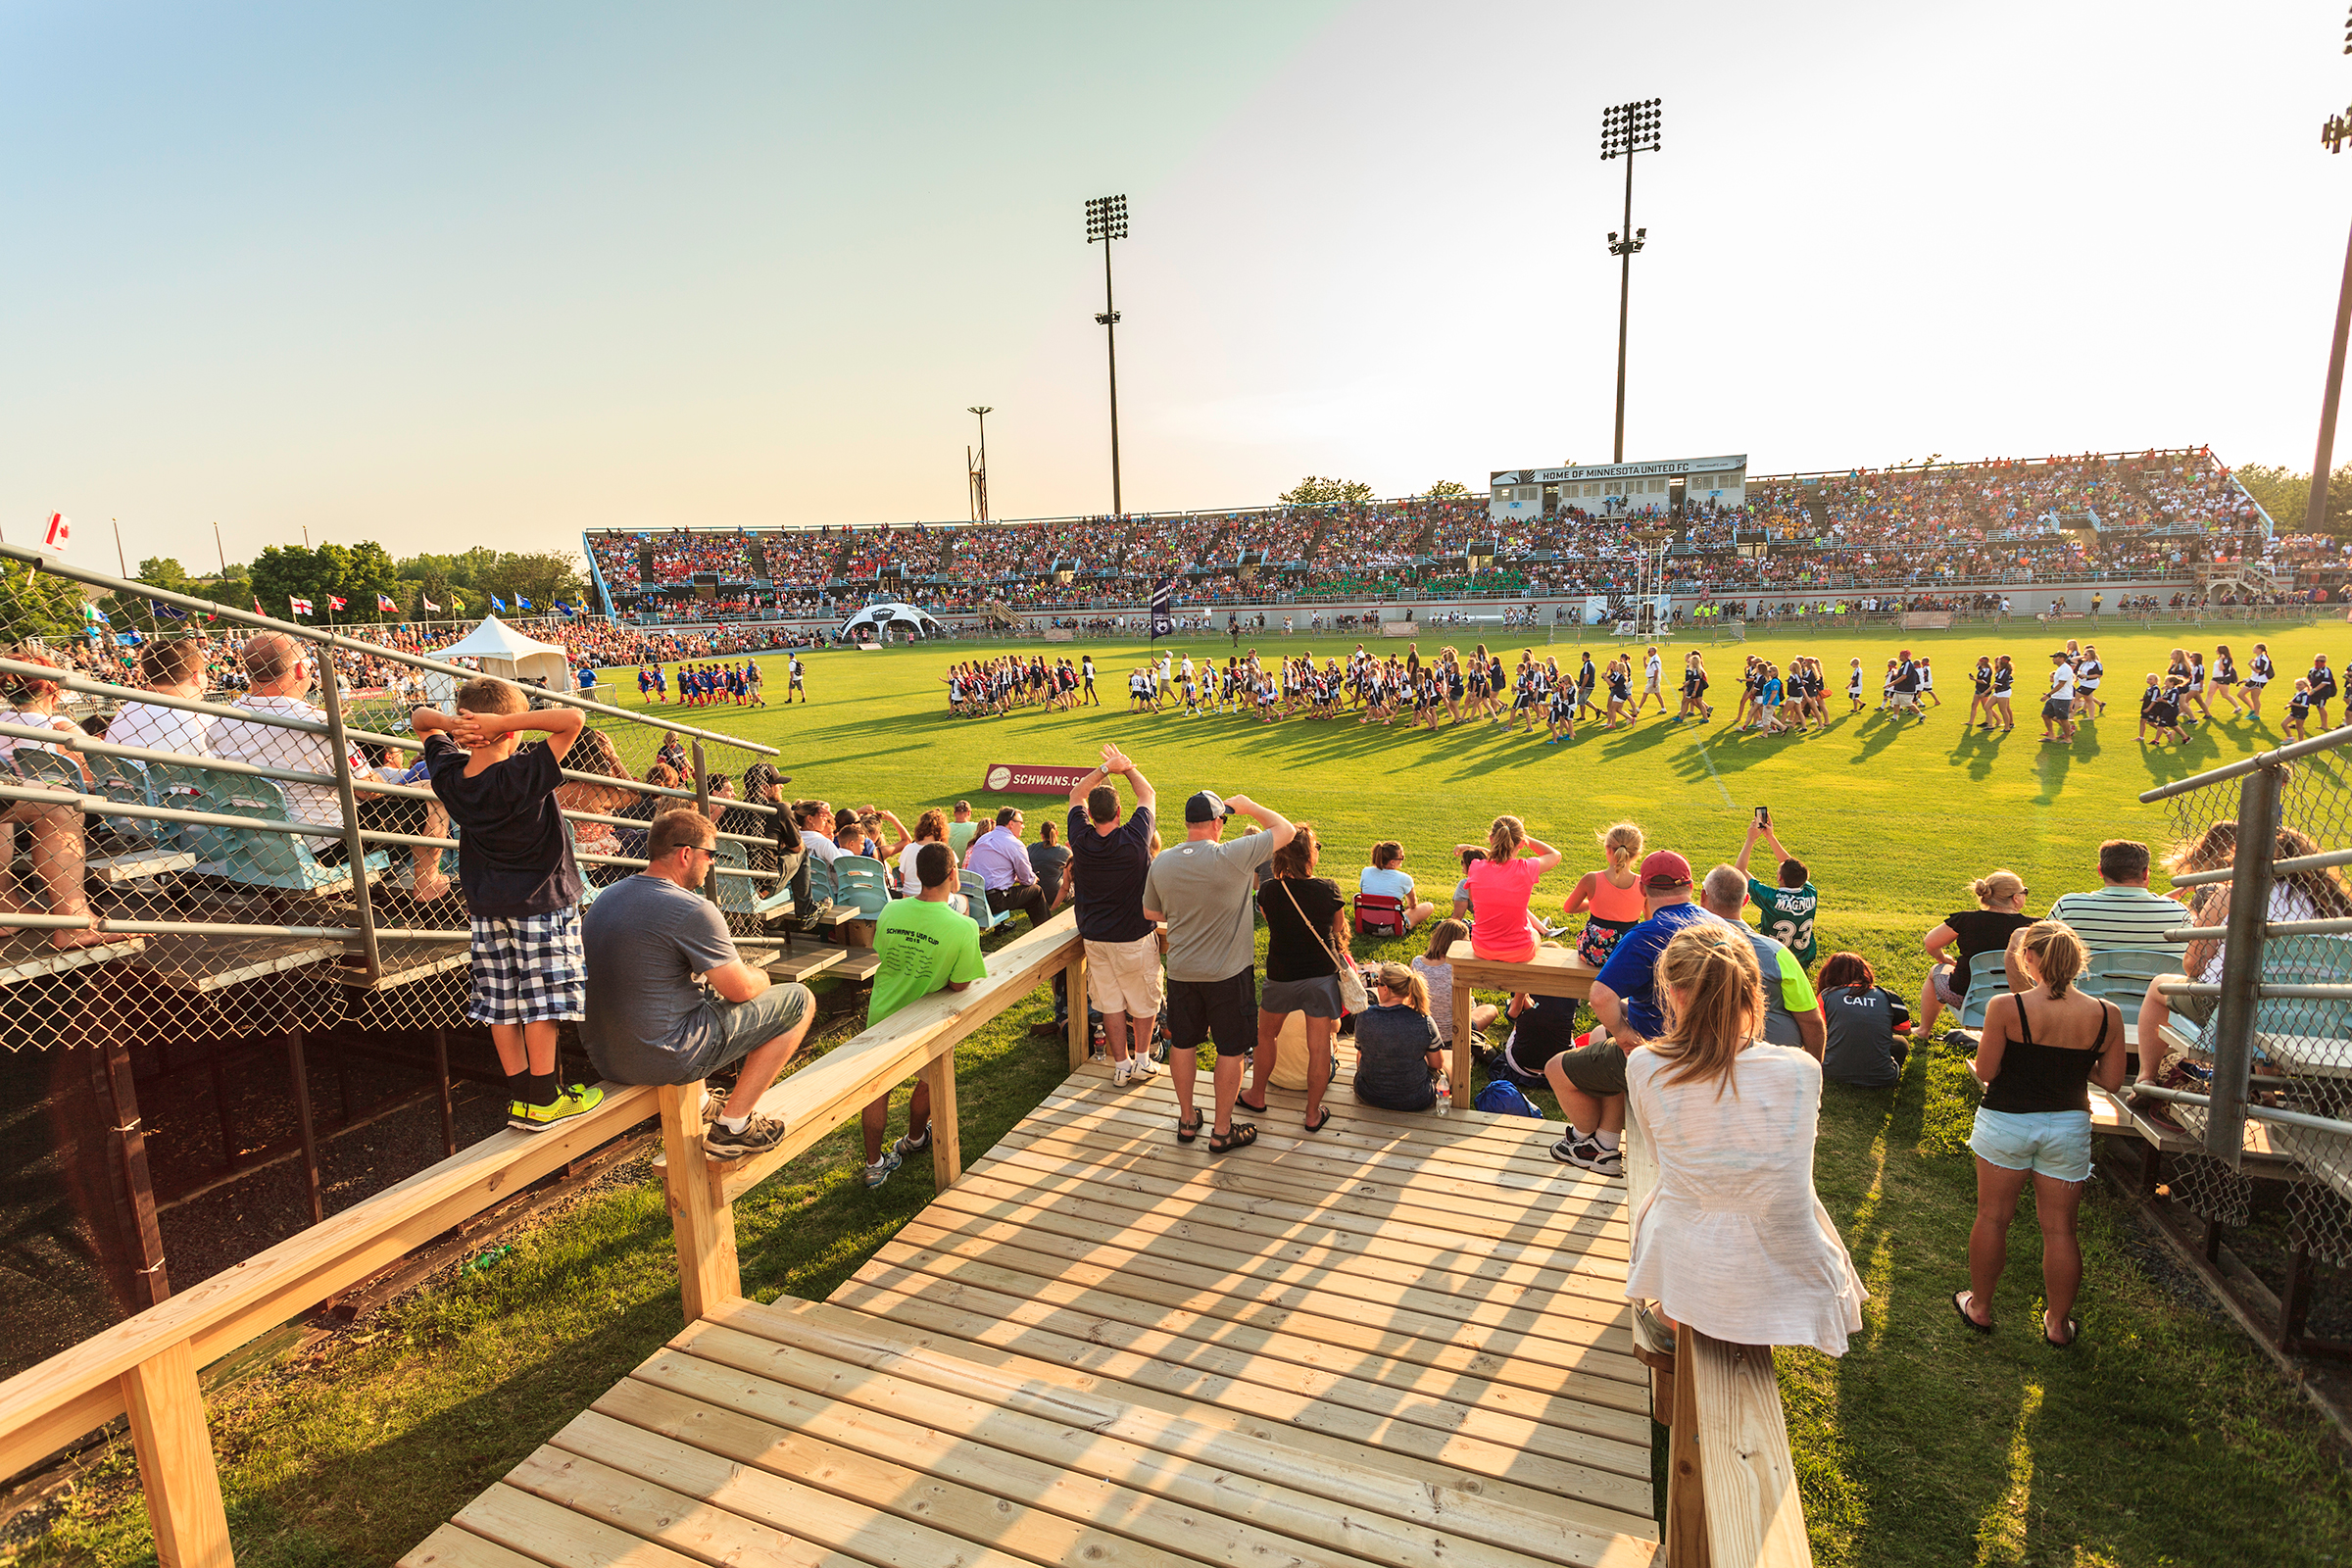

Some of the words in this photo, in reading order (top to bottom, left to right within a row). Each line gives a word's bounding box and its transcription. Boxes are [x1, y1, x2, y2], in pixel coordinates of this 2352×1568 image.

[1543, 471, 1570, 480] HOME
[1586, 466, 1640, 478] MINNESOTA
[1641, 464, 1675, 474] UNITED
[1677, 463, 1690, 471] FC
[886, 928, 915, 937] SCHWAN'S
[916, 932, 928, 941] USA
[928, 936, 940, 946] CUP
[1770, 918, 1814, 951] 33
[1843, 995, 1877, 1007] CAIT
